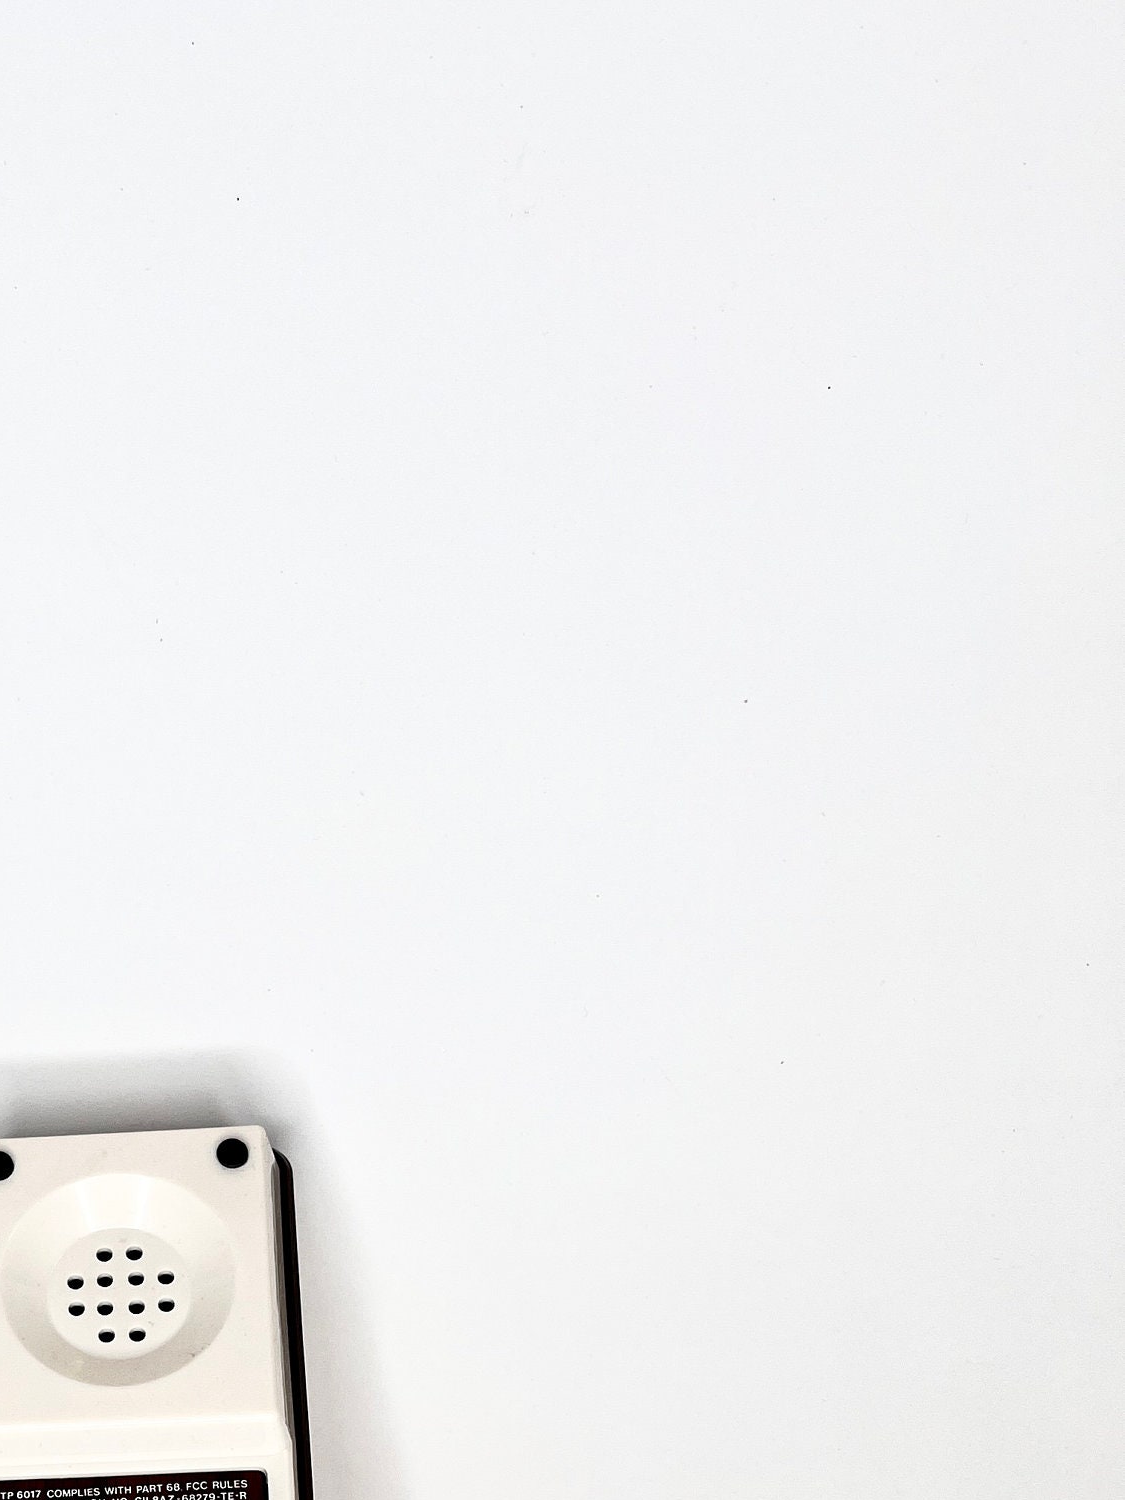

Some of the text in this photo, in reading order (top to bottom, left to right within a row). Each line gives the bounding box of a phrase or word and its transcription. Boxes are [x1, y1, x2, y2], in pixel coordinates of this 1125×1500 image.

[0, 1491, 14, 1500] TP
[16, 1489, 41, 1499] 6017
[46, 1487, 100, 1498] COMPLIES
[104, 1485, 132, 1496] WITH
[136, 1484, 163, 1493] PART
[186, 1481, 208, 1490] FCC
[212, 1479, 248, 1489] RULES
